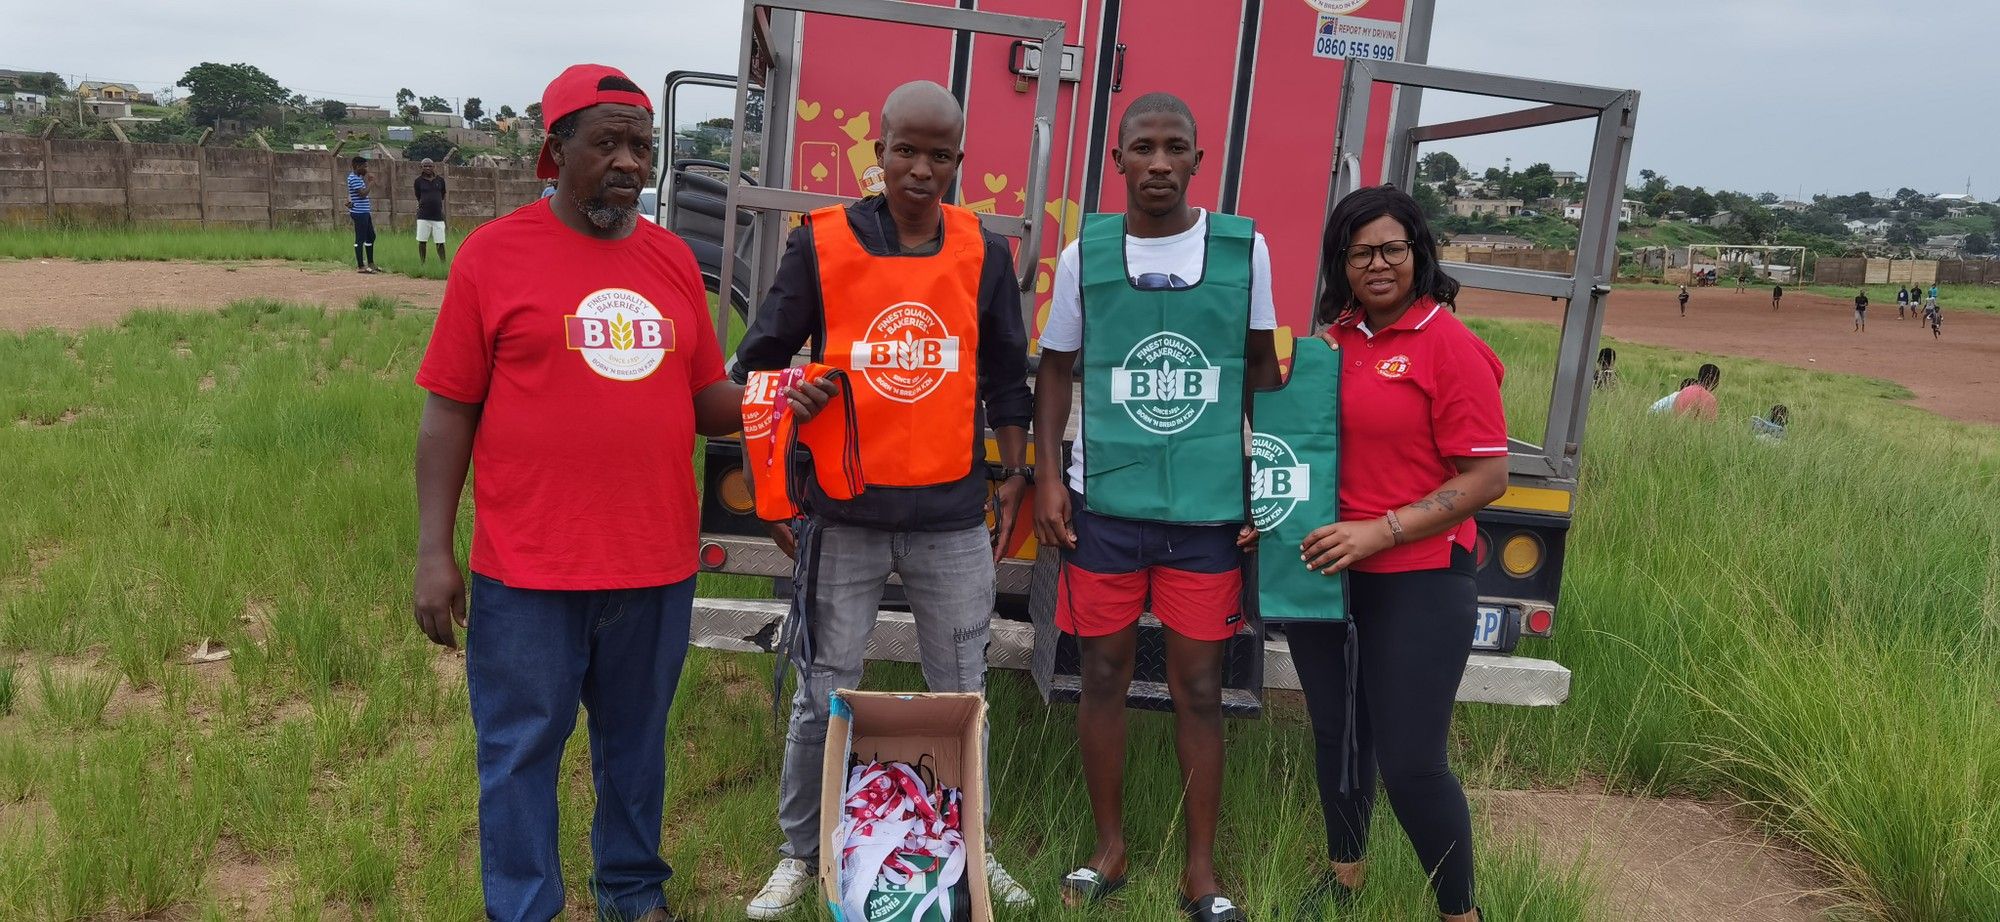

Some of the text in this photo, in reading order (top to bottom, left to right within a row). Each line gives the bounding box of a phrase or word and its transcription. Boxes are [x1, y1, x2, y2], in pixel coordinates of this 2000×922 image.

[1339, 24, 1361, 36] REPORT
[1363, 27, 1372, 35] MY
[1372, 29, 1397, 39] DRIVING
[1317, 37, 1346, 56] 0860
[1349, 41, 1369, 58] 555
[1373, 44, 1394, 61] 999
[587, 292, 649, 310] FINEST QUALITY
[597, 301, 640, 314] BAKERIES
[877, 308, 935, 333] FINEST QUALITY
[887, 317, 928, 335] BAKERIES
[1136, 338, 1197, 360] FINEST QUALITY
[1146, 347, 1187, 364] BAKERIES
[592, 358, 608, 371] BORN
[1136, 409, 1153, 424] BORN
[1251, 447, 1276, 462] ERIES
[1252, 439, 1285, 457] QUALITY
[1271, 469, 1292, 496] B
[870, 897, 901, 920] FINEST
